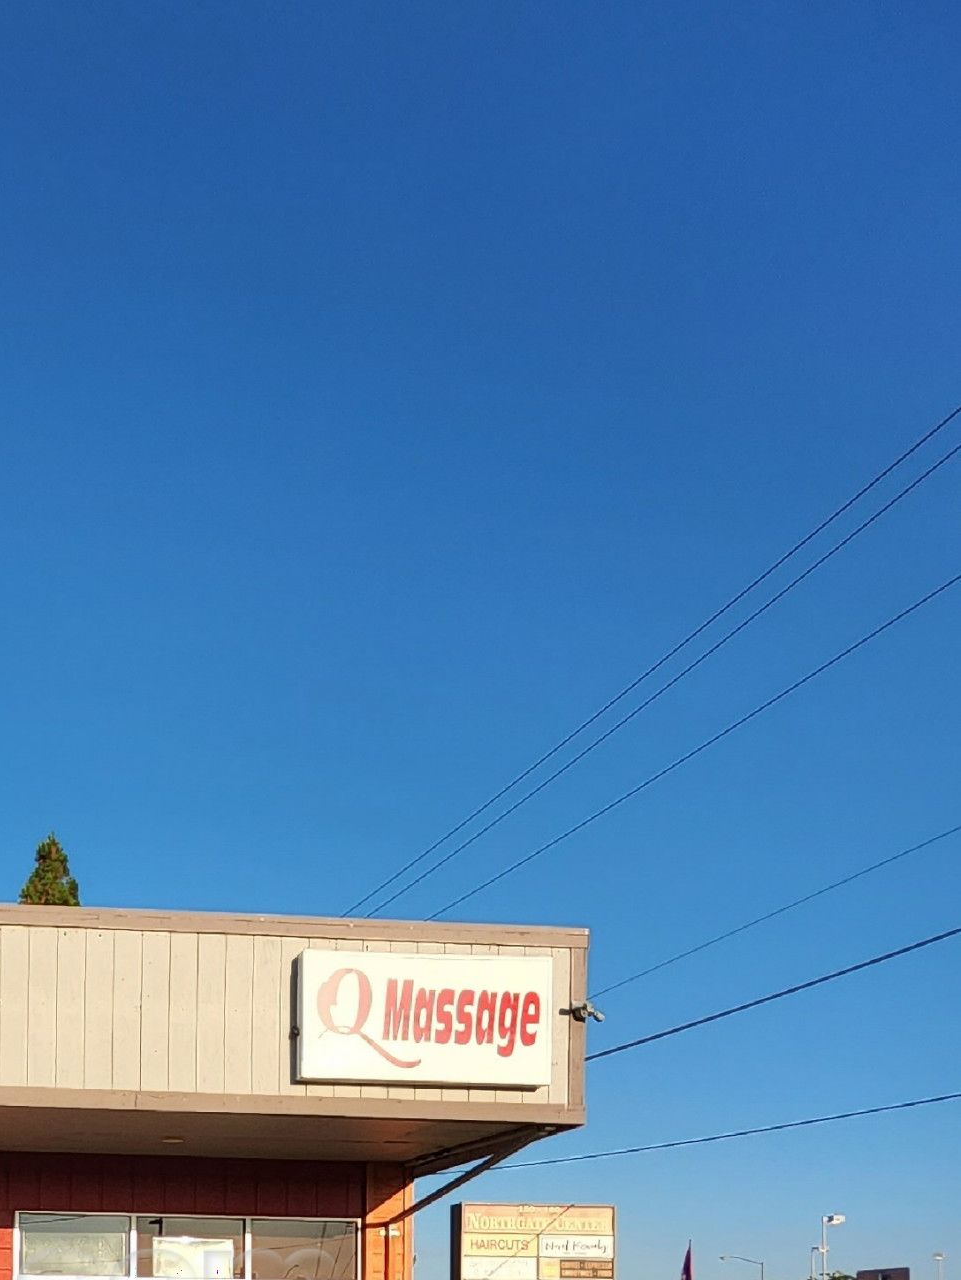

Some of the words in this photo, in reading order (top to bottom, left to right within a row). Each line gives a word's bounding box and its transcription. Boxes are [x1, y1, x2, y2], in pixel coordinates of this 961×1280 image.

[317, 968, 422, 1068] Q
[382, 977, 541, 1058] Massage
[470, 1239, 530, 1251] HAIRCUTS
